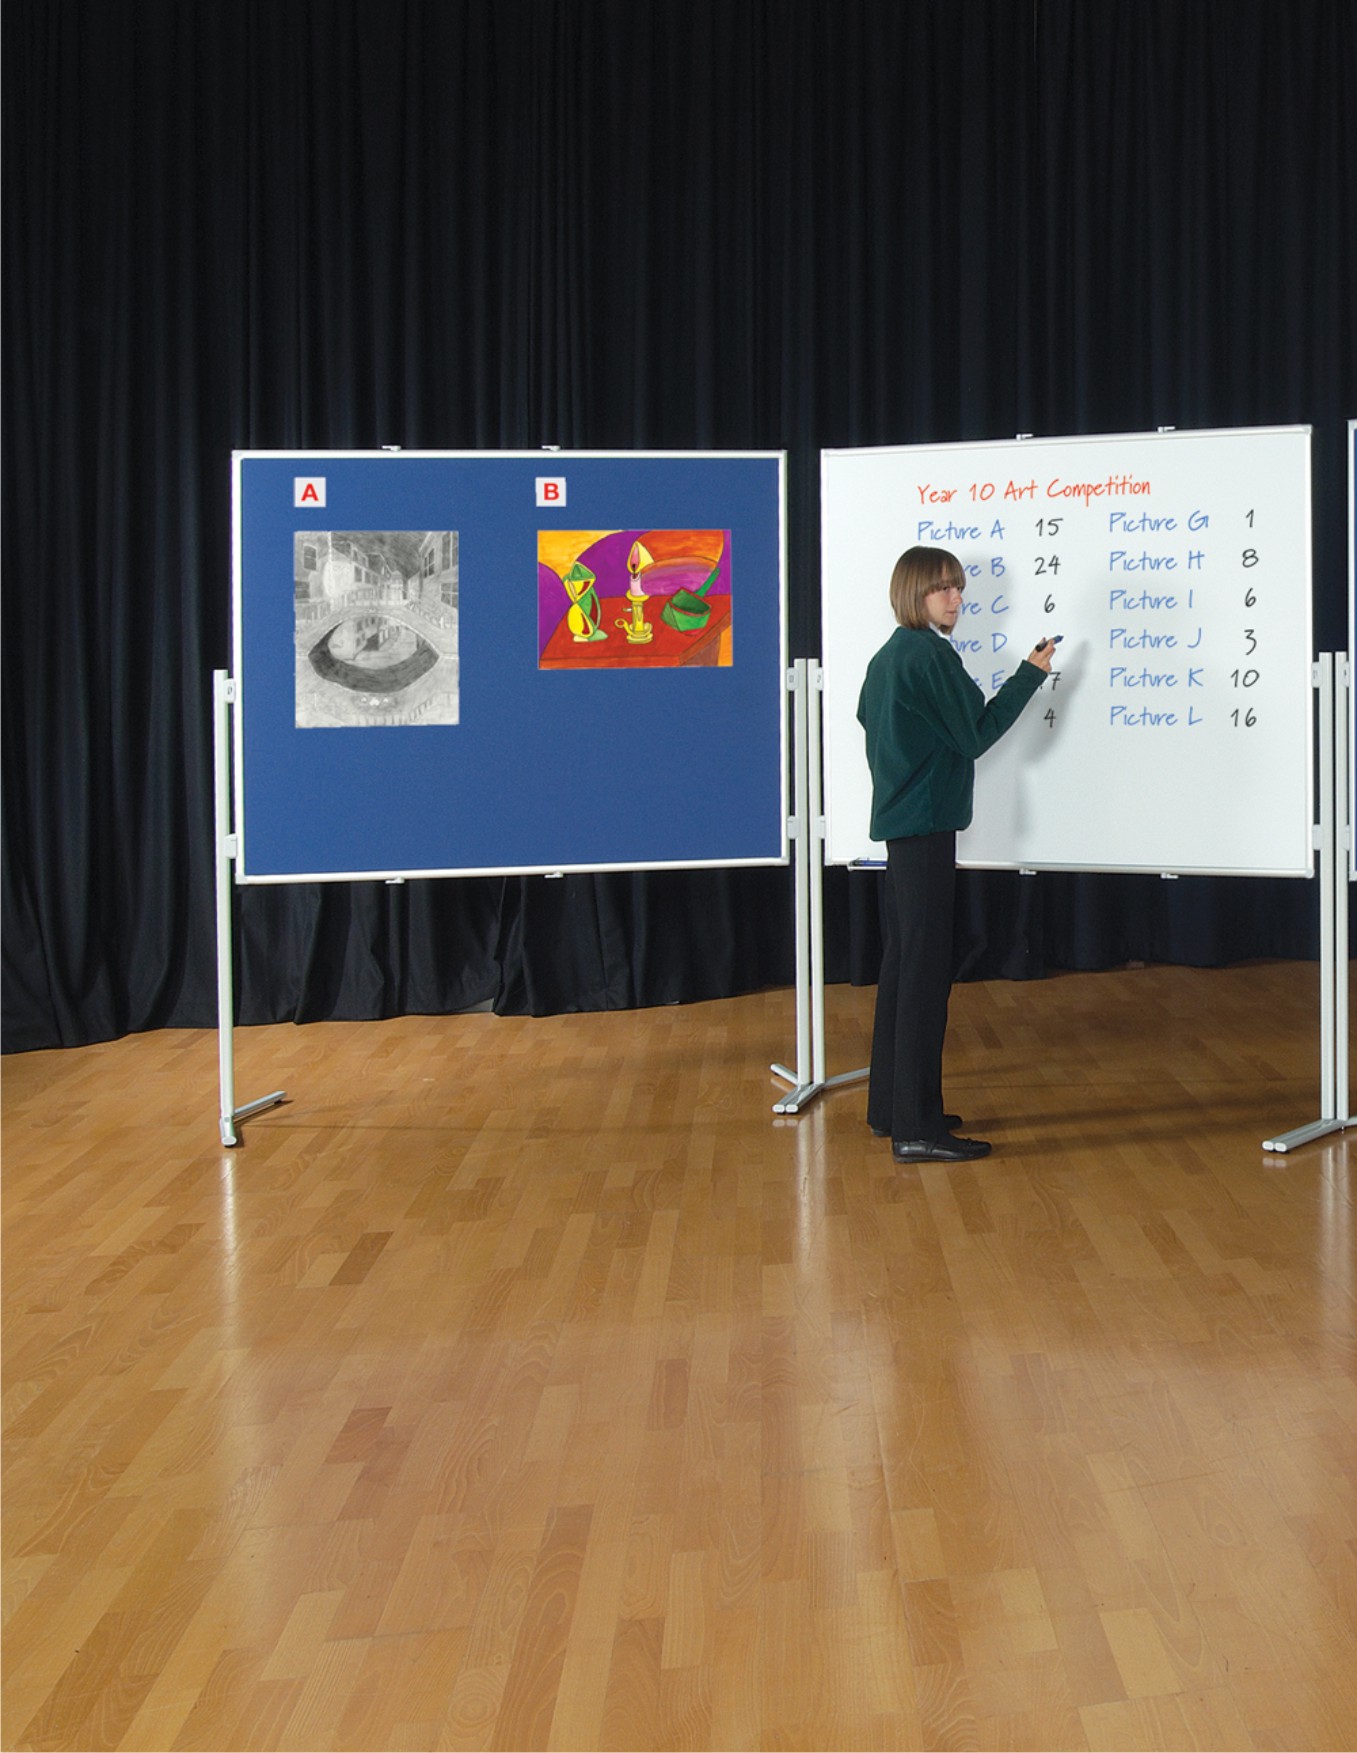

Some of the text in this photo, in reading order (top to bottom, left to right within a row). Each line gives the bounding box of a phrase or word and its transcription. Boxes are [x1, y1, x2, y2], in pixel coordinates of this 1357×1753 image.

[300, 482, 320, 503] A
[543, 481, 560, 501] B
[917, 474, 1151, 507] Year 10 Art Competition
[917, 518, 1064, 541] Picture A 15
[1109, 509, 1254, 533] Picture G 1
[991, 557, 1006, 577] B
[1034, 555, 1061, 576] 24
[1109, 548, 1259, 572] Picture H 8
[991, 595, 1009, 614] C
[1044, 594, 1056, 614] 6
[1109, 588, 1178, 610] Picture
[1244, 587, 1257, 608] 6
[991, 632, 1008, 653] D
[1109, 627, 1257, 656] Picture J 3
[991, 669, 1008, 690] E
[1109, 666, 1260, 688] Picture K 10
[1043, 707, 1057, 729] 4
[1109, 705, 1257, 728] Picture L 16
